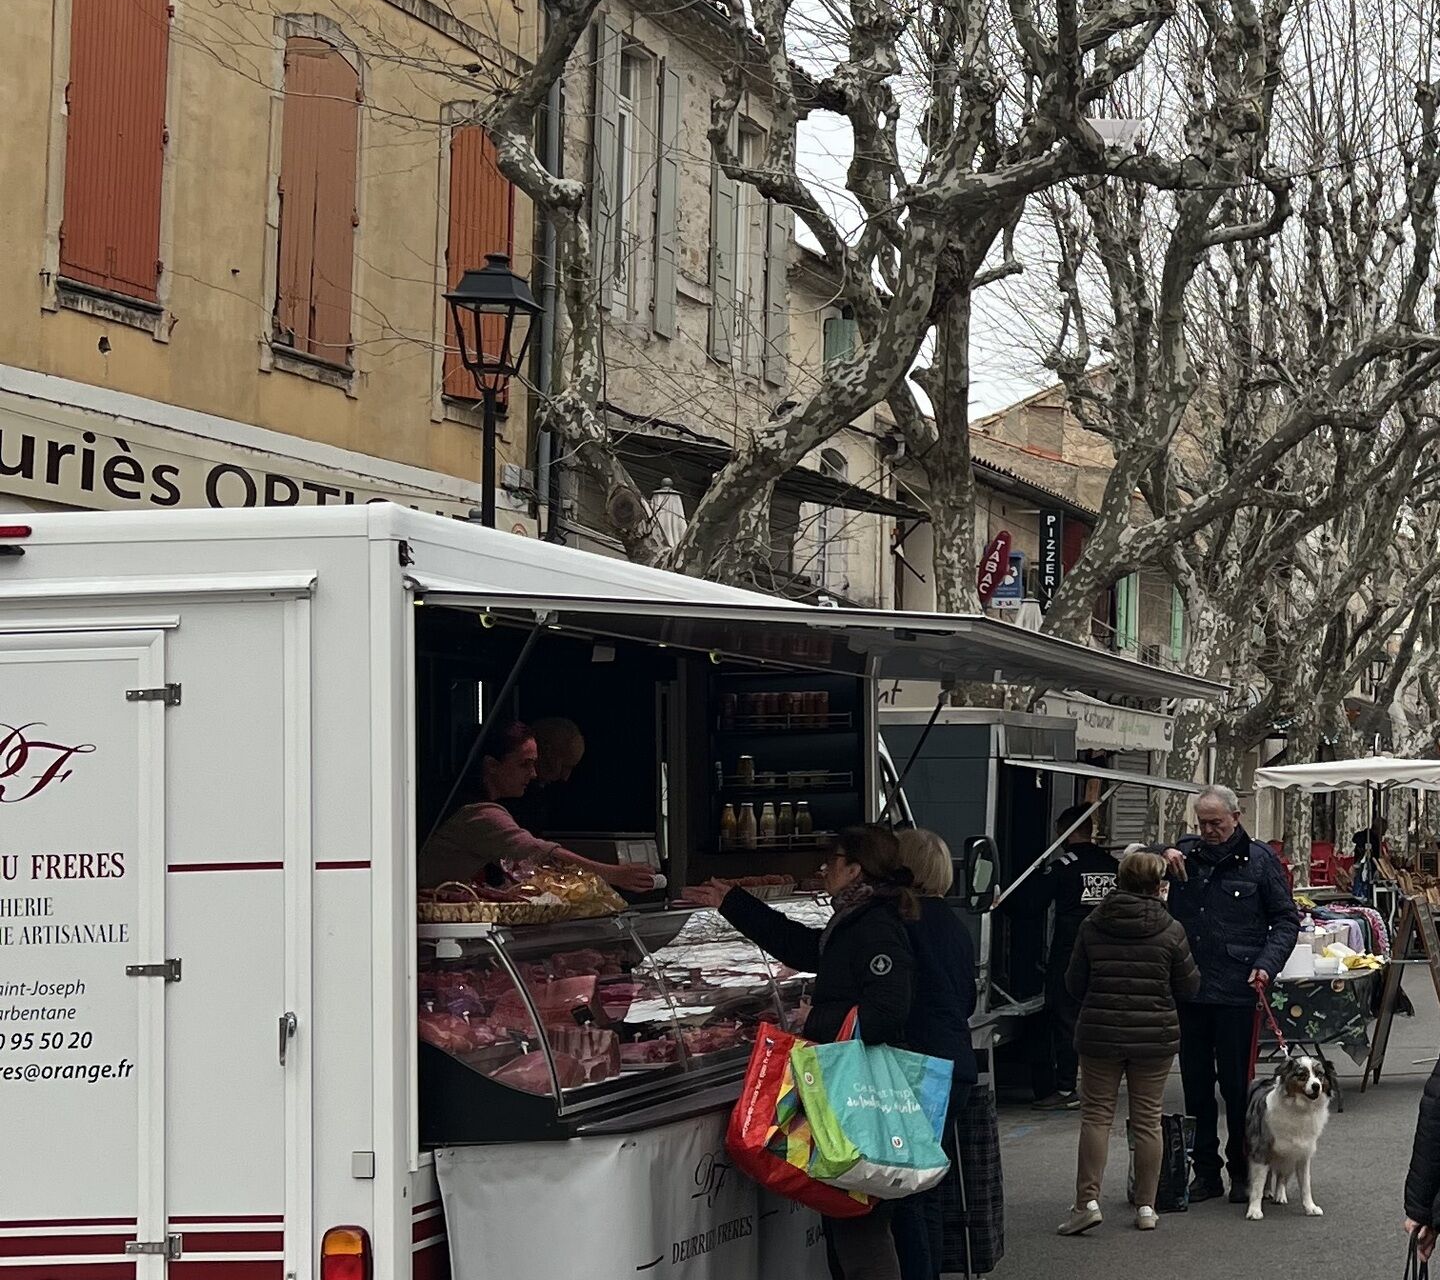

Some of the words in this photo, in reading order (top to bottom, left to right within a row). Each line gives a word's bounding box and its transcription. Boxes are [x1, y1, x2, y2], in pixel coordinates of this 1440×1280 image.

[978, 538, 1007, 596] TABAC
[31, 852, 125, 880] FRERES
[19, 923, 130, 945] ARTISANALE
[10, 1032, 35, 1051] 95
[39, 1031, 64, 1050] 50
[67, 1031, 93, 1049] 20
[717, 1214, 753, 1246] FRERES
